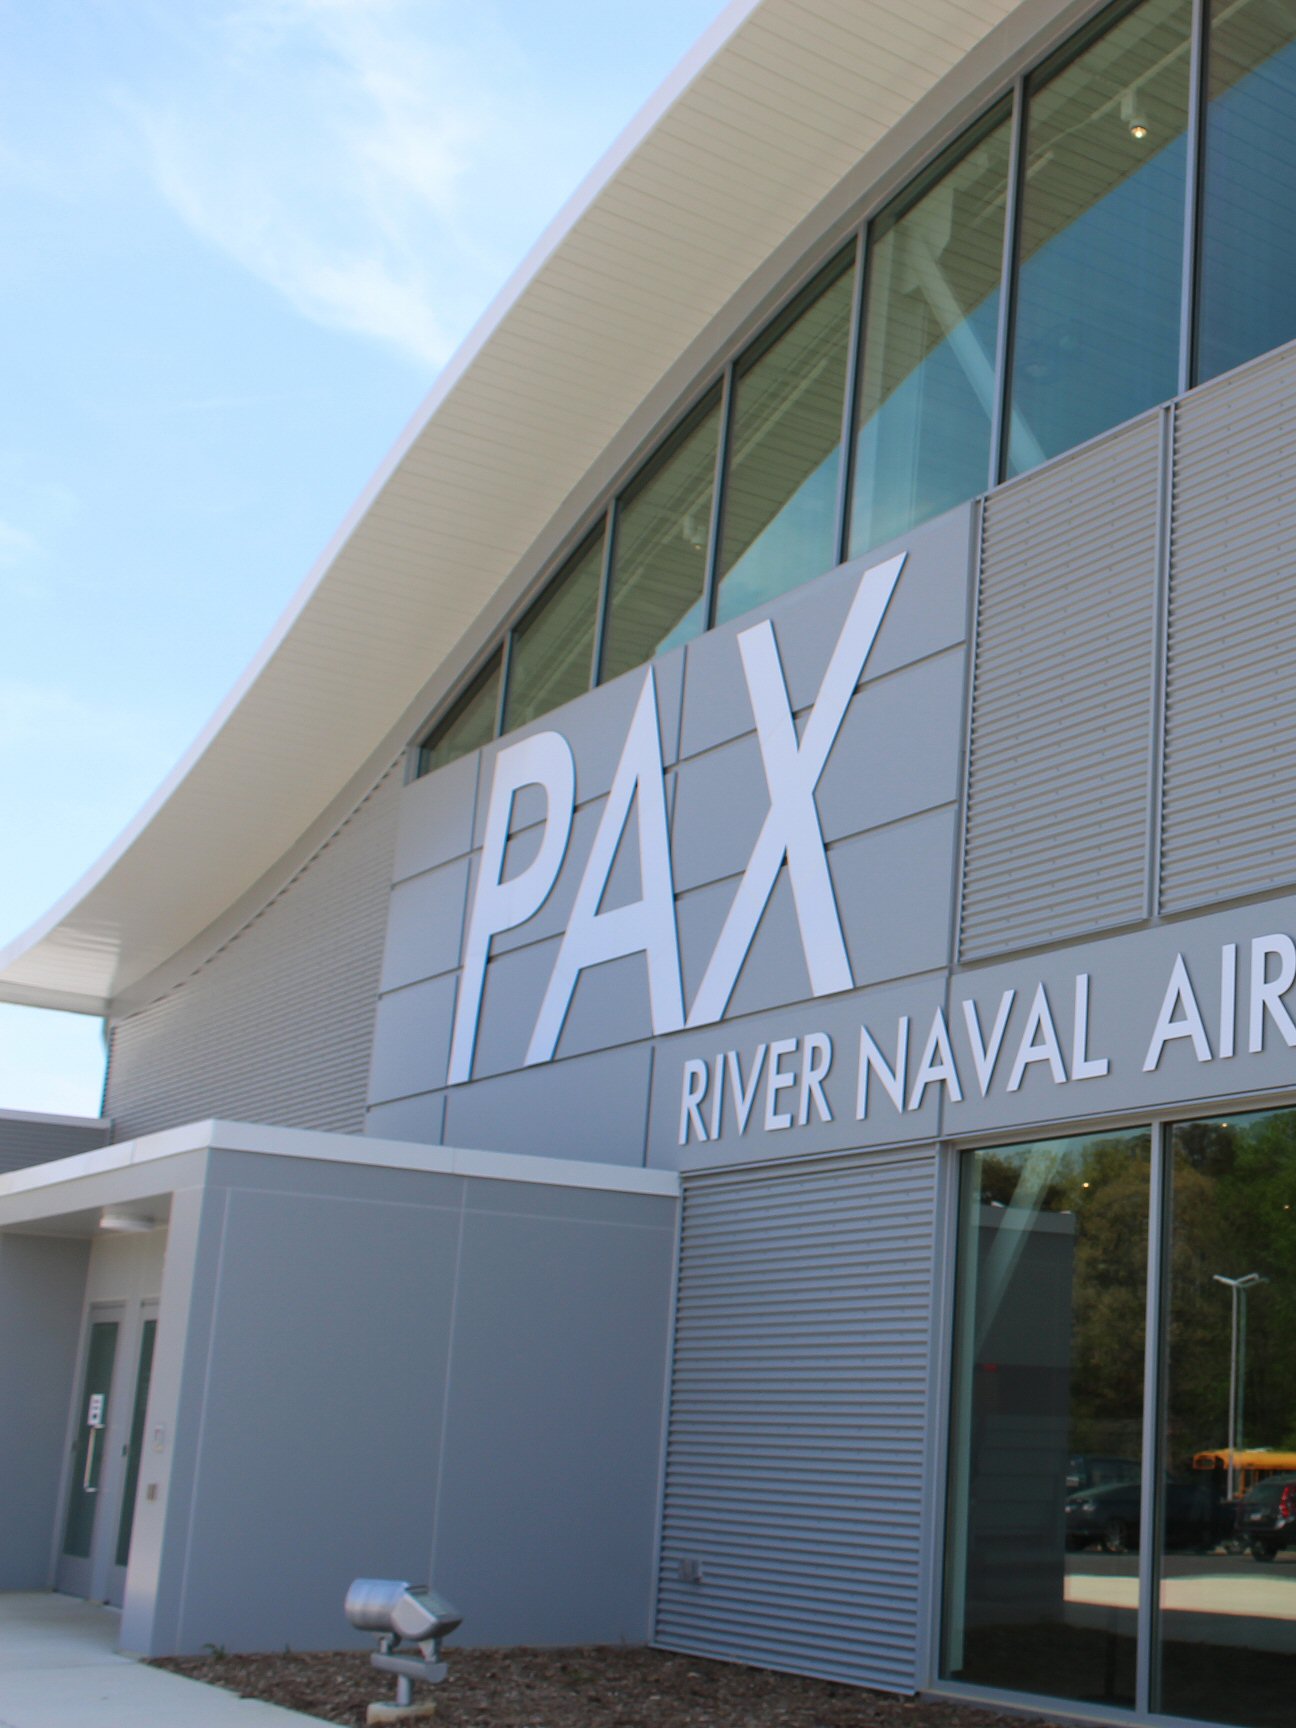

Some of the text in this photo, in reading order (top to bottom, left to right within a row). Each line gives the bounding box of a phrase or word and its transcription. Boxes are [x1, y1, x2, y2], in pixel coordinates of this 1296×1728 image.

[447, 551, 908, 1086] PAX
[678, 1032, 833, 1145] RIVER
[856, 973, 1108, 1121] NAVAL
